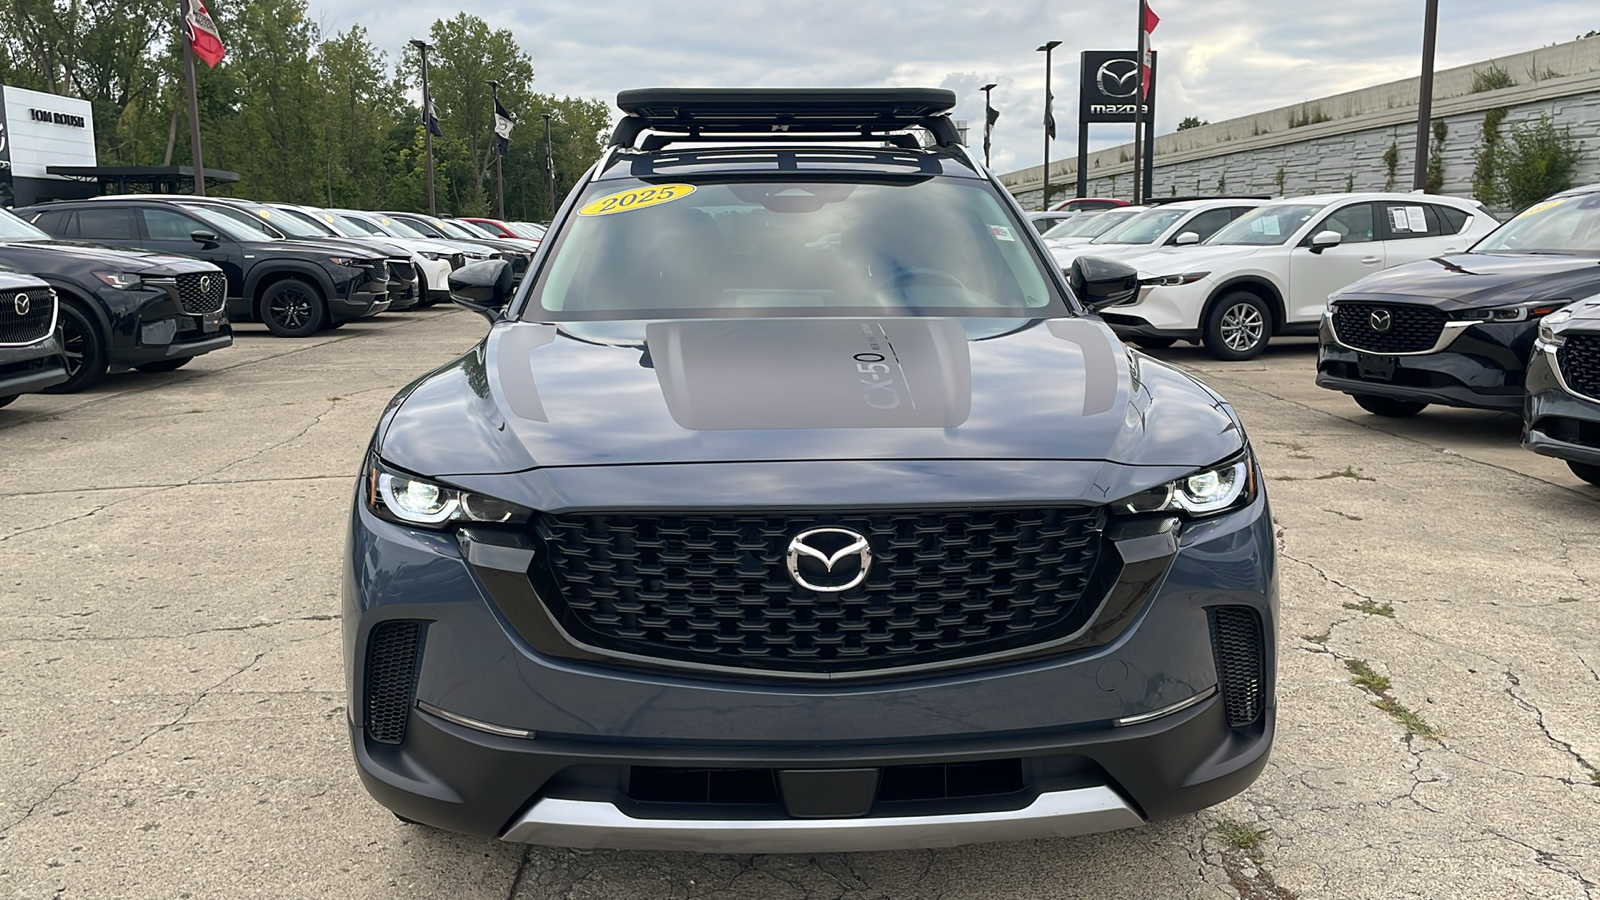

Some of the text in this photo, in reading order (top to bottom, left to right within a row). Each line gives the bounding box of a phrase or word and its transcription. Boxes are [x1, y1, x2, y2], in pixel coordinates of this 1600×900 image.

[29, 108, 85, 128] TOM ROUSH
[599, 186, 675, 212] 2025
[853, 353, 900, 409] CX-50
